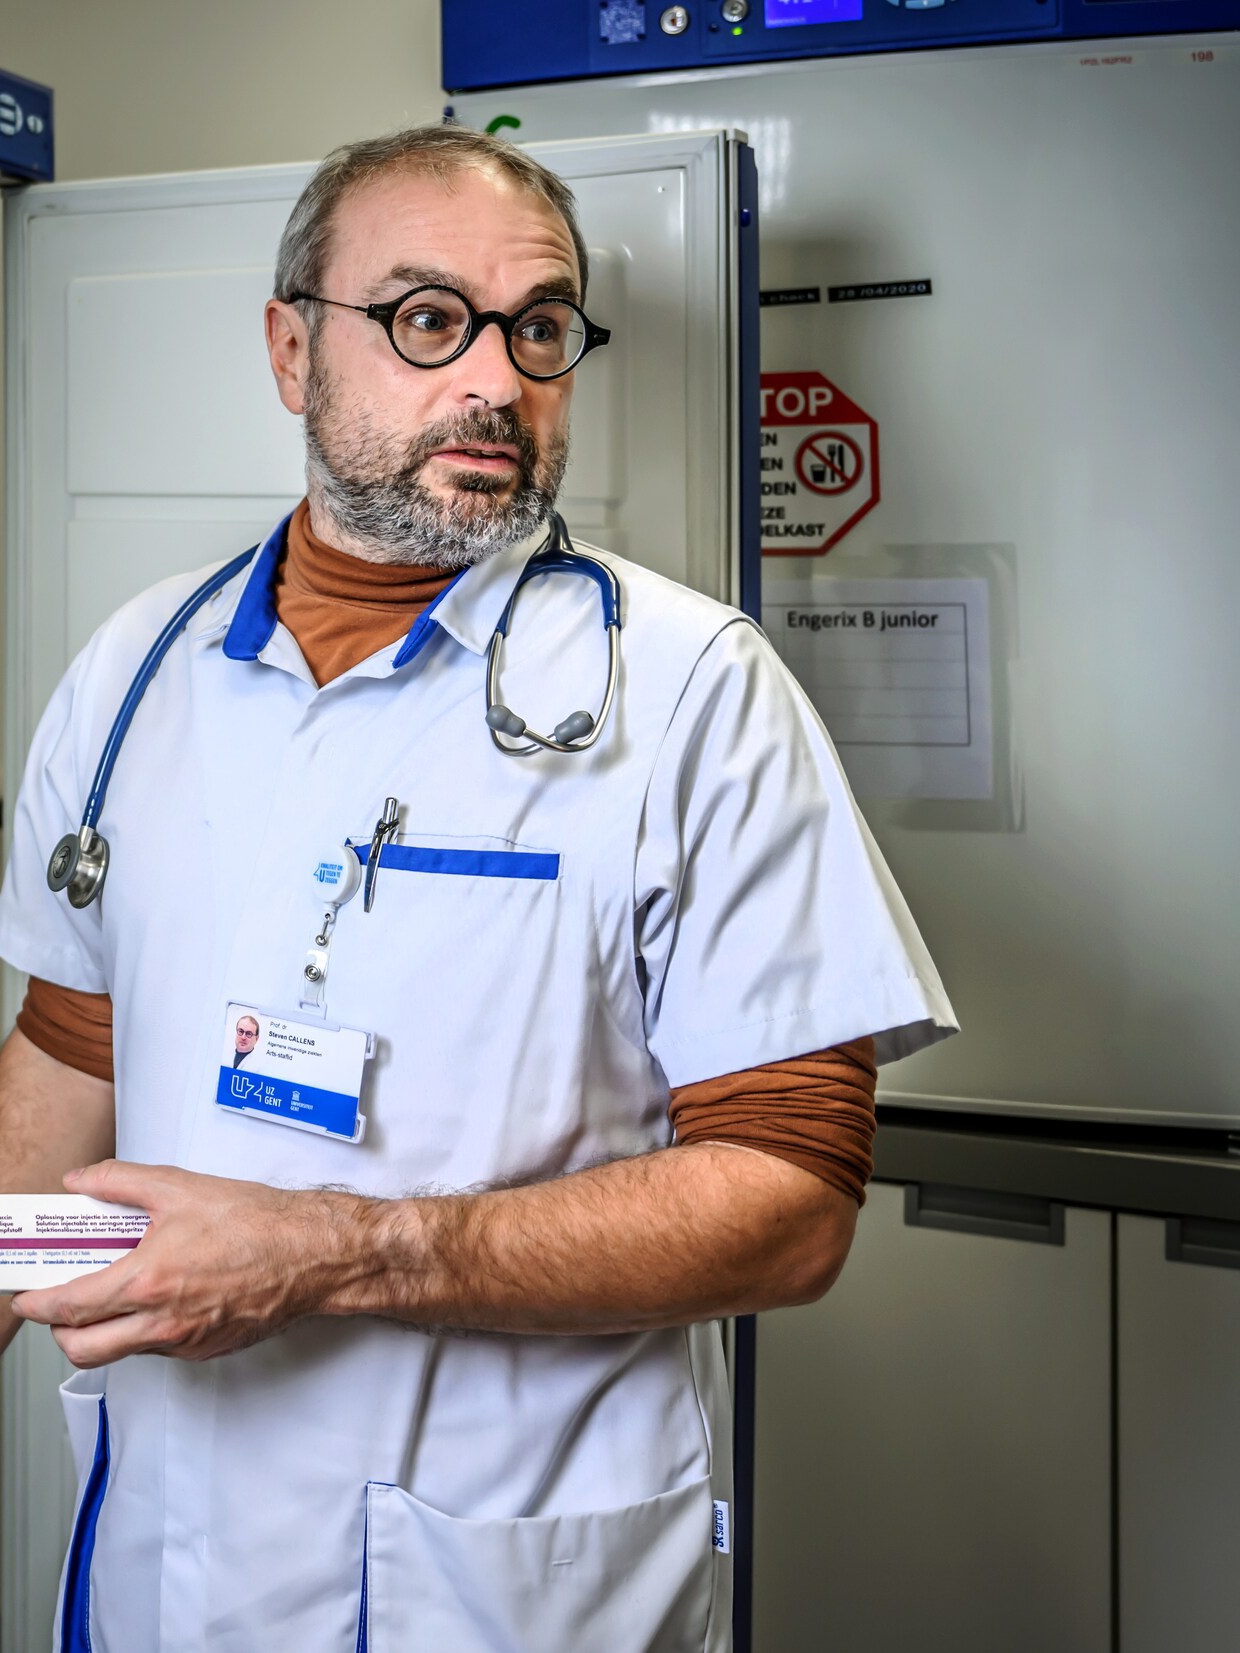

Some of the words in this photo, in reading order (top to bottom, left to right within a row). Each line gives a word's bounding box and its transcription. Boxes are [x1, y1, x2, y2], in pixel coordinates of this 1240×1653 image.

[1191, 51, 1214, 63] 198
[787, 611, 857, 632] Engerix
[863, 611, 876, 628] B
[880, 612, 939, 632] junior
[269, 1031, 288, 1040] Steven
[288, 1035, 315, 1046] CALLENS
[265, 1086, 275, 1096] UZ
[264, 1096, 282, 1107] GENT
[715, 1509, 724, 1536] sarco
